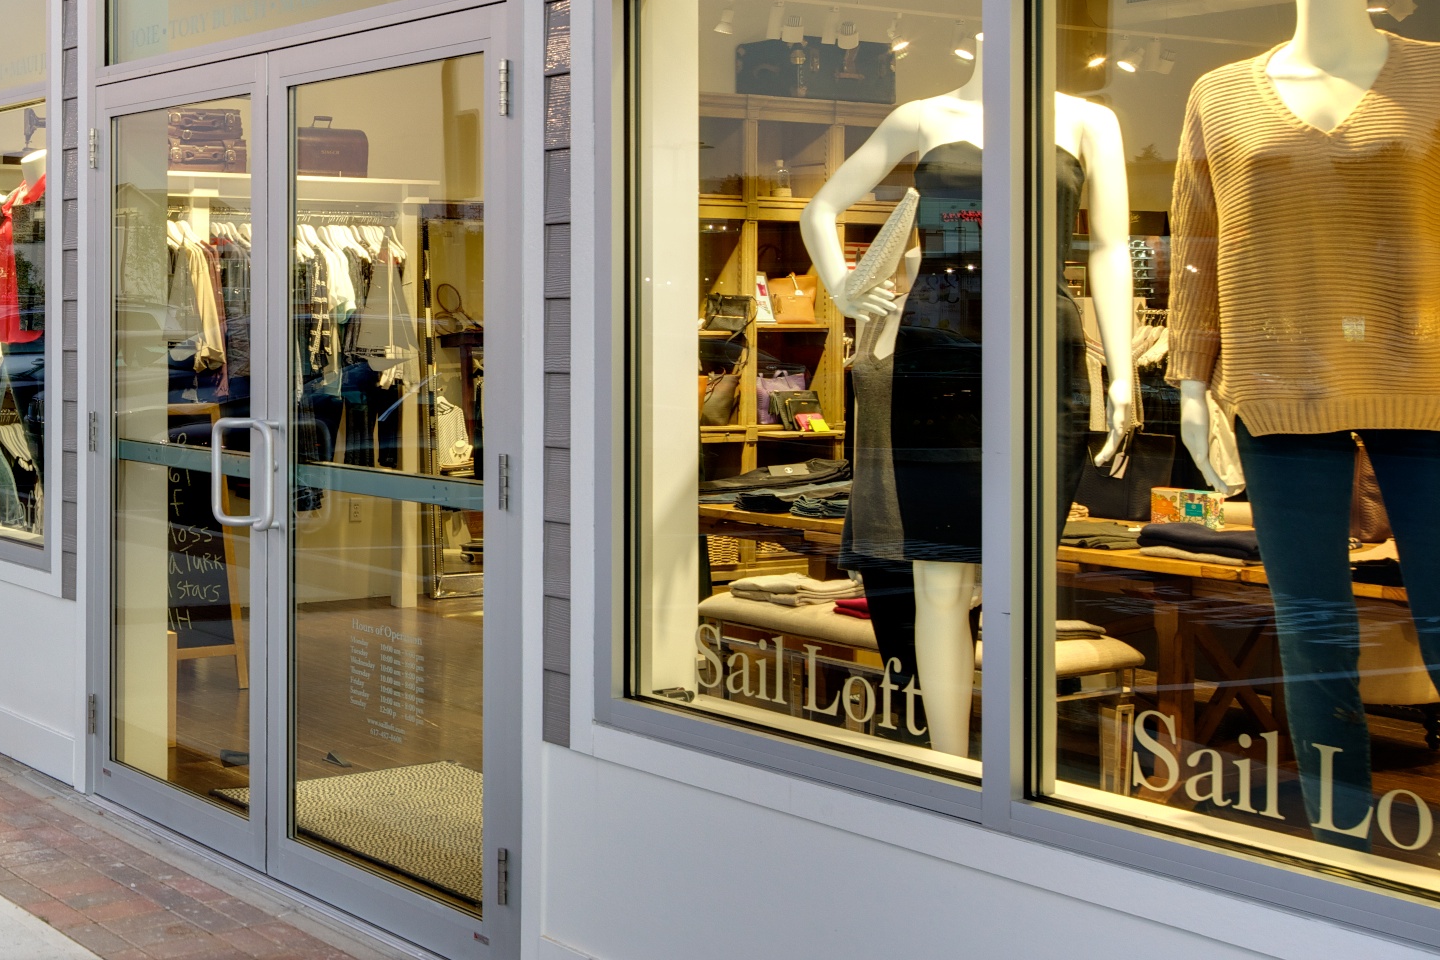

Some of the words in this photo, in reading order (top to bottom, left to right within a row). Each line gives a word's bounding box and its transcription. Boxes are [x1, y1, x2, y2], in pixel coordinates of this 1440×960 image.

[168, 13, 206, 40] TORY
[351, 617, 374, 634] Hours
[375, 624, 384, 636] of
[693, 623, 786, 706] Sail
[802, 643, 927, 737] Loft
[1132, 708, 1287, 821] Sail
[1311, 742, 1440, 852] Lo
